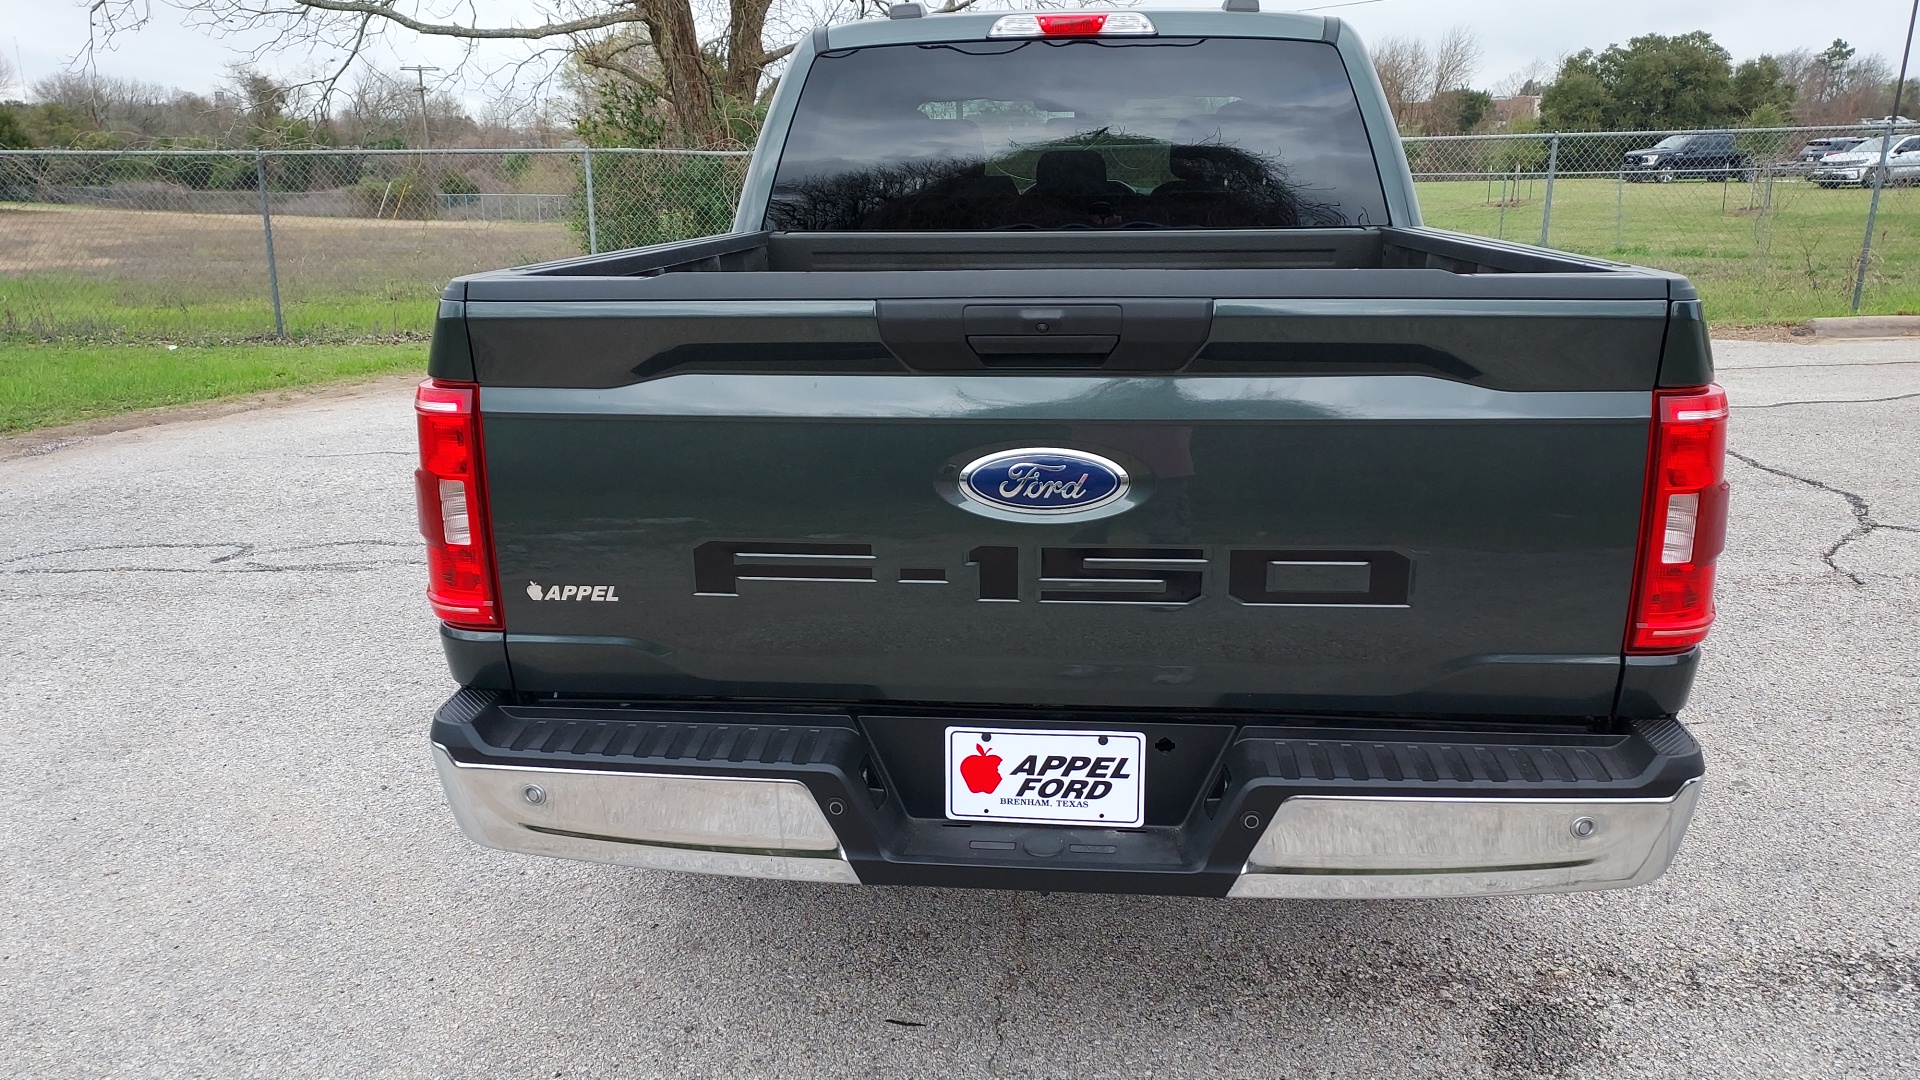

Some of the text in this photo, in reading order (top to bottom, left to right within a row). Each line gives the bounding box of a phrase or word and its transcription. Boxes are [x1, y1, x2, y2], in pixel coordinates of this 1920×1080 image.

[999, 462, 1089, 499] Ford
[693, 540, 1412, 608] F-150
[544, 585, 619, 602] APPEL
[1010, 755, 1130, 778] APPEL
[1016, 779, 1112, 799] FORD
[1000, 797, 1089, 809] BRENHAM, TEXAS
